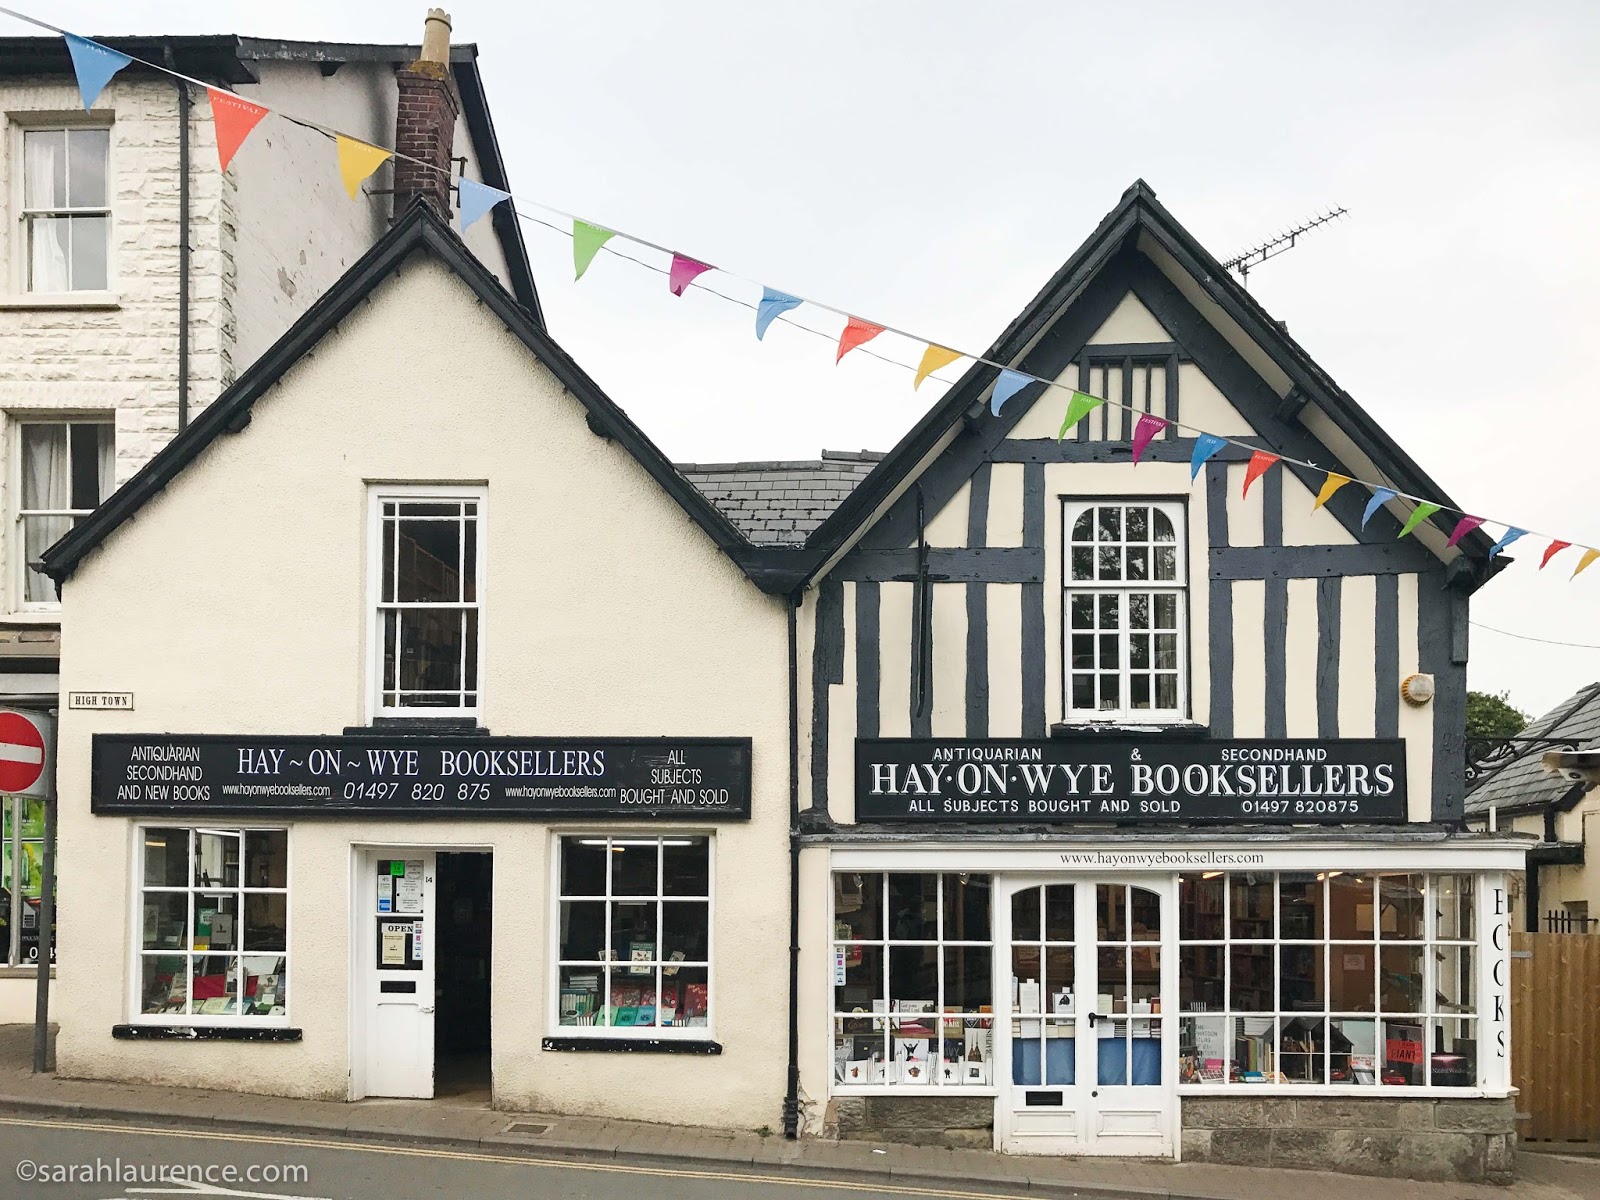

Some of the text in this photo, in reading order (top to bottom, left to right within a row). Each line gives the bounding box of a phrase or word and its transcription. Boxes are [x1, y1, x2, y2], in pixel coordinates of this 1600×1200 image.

[212, 96, 262, 115] FESTIVAL
[75, 695, 127, 706] HIGH TOWN
[131, 746, 200, 762] ANTIQUARIAN
[667, 749, 686, 765] ALL
[932, 748, 1327, 761] ANTIQUARIAN & SECONDHAND
[237, 748, 285, 775] HAY
[308, 749, 342, 775] ON
[366, 749, 419, 776] WYE
[440, 750, 605, 777] BOOKSELLERS
[126, 765, 203, 781] SECONDHAND
[651, 768, 702, 785] SUBJECTS
[1130, 763, 1395, 797] BOOKSELLERS
[117, 785, 210, 801] AND NEW BOOKS
[222, 782, 617, 801] www.hayonwyebooksellers.com 01497 820 875 www.hayonwyebooksellers.com
[620, 788, 729, 805] BOUGHT AND SOLD
[909, 800, 1359, 813] ALL SUBJECTS BOUGHT AND SOLD 01497 820875
[1060, 852, 1264, 867] www.hayonwyebooksellers.com
[388, 925, 413, 933] OPEN
